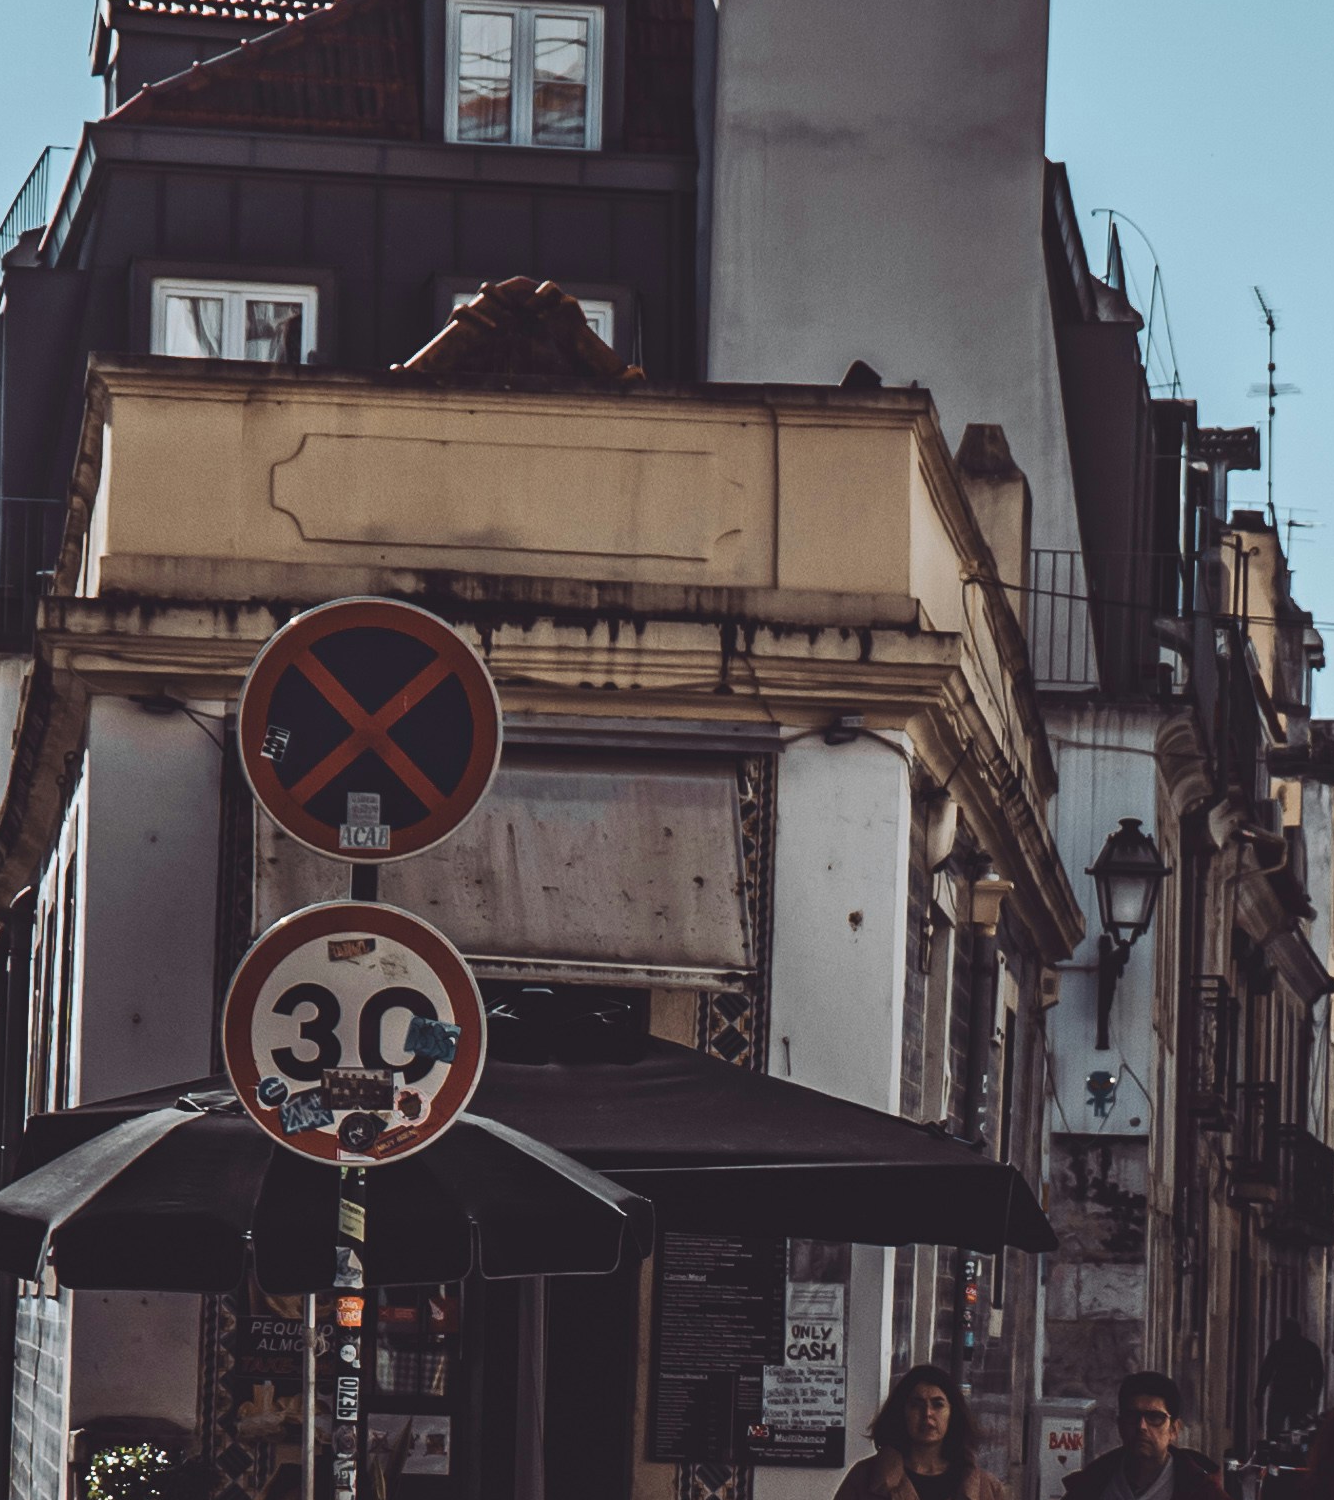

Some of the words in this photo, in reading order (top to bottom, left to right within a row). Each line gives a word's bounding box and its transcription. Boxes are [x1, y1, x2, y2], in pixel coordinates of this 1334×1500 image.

[341, 827, 389, 847] ACAB
[271, 982, 440, 1085] 30
[791, 1324, 833, 1341] ONLY
[786, 1342, 837, 1361] CASH
[1049, 1431, 1084, 1451] BANK
